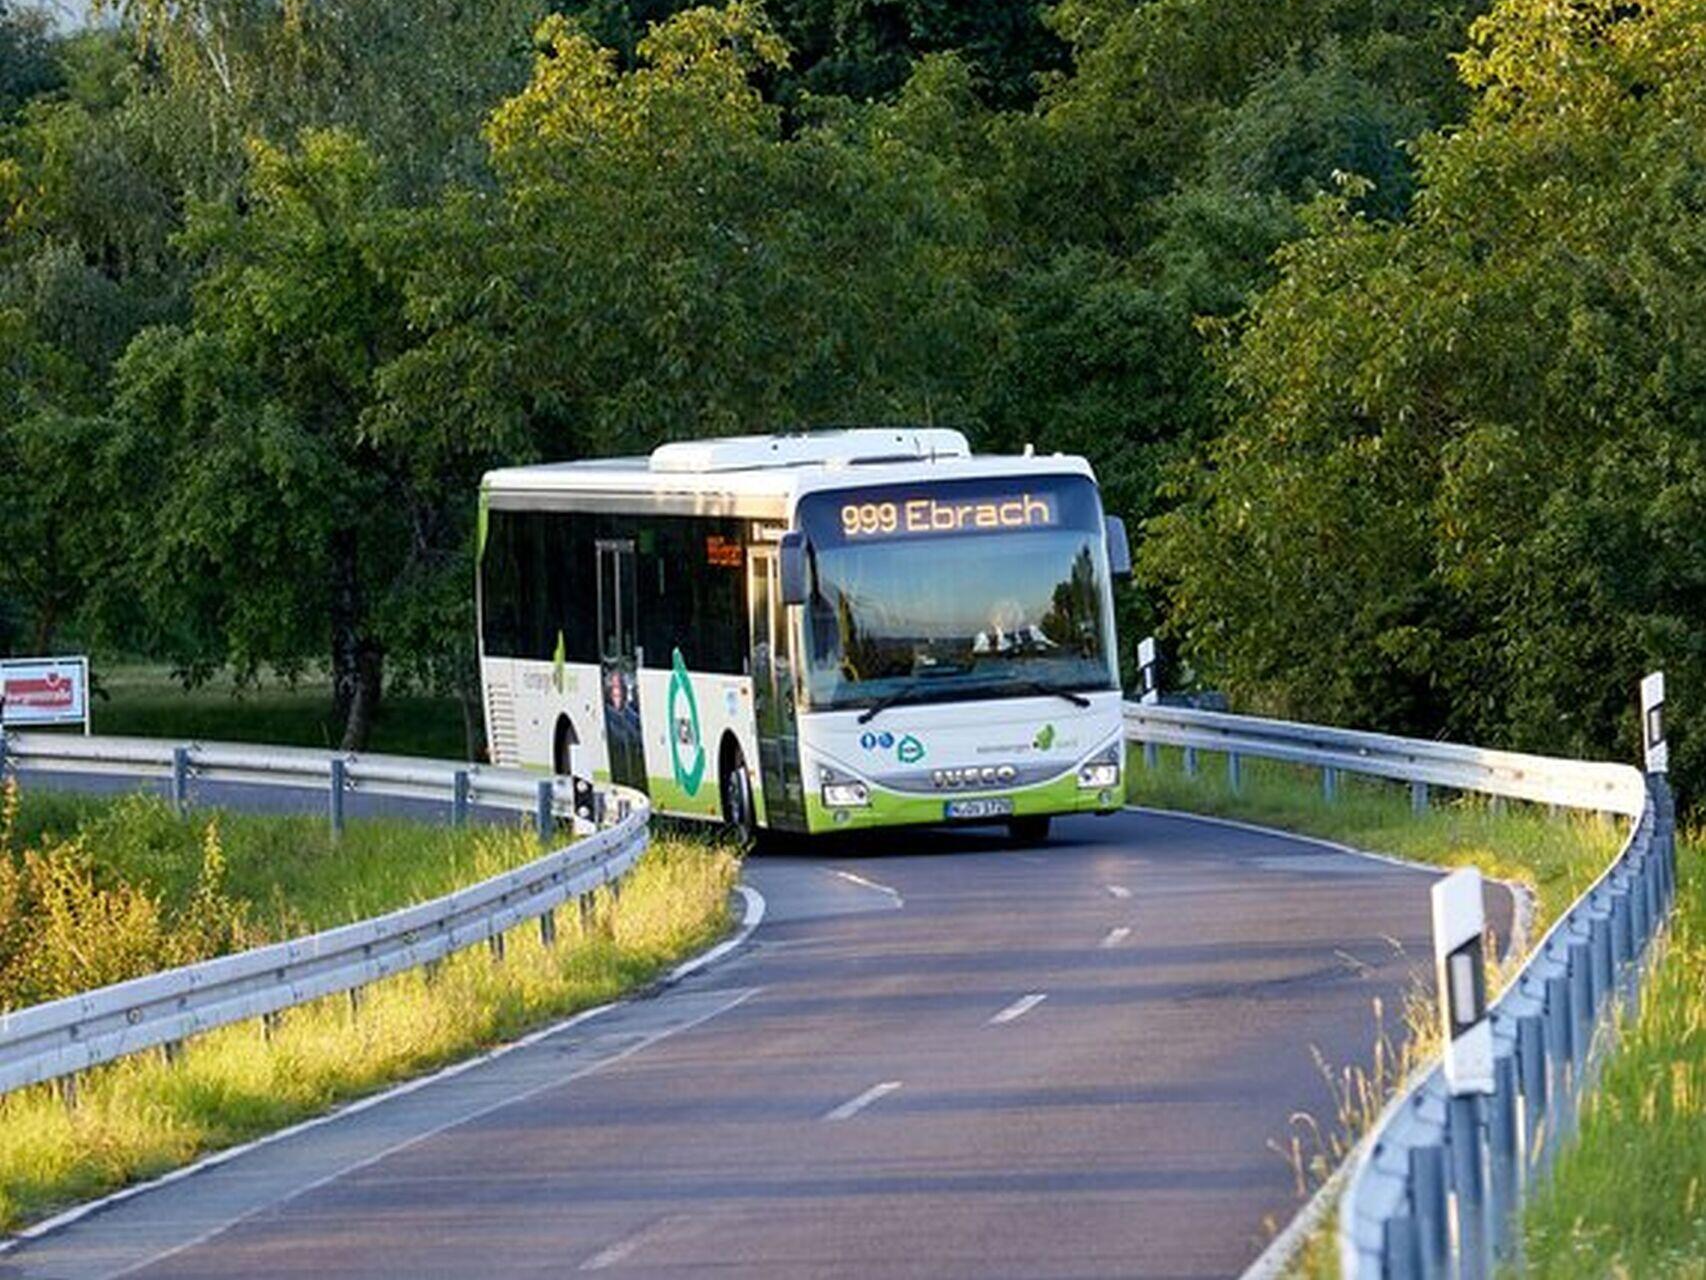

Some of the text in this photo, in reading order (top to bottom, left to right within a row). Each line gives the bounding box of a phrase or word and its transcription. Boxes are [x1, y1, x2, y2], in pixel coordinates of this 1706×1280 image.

[841, 494, 1049, 534] 999 Ebrach
[933, 765, 1016, 788] IVECO
